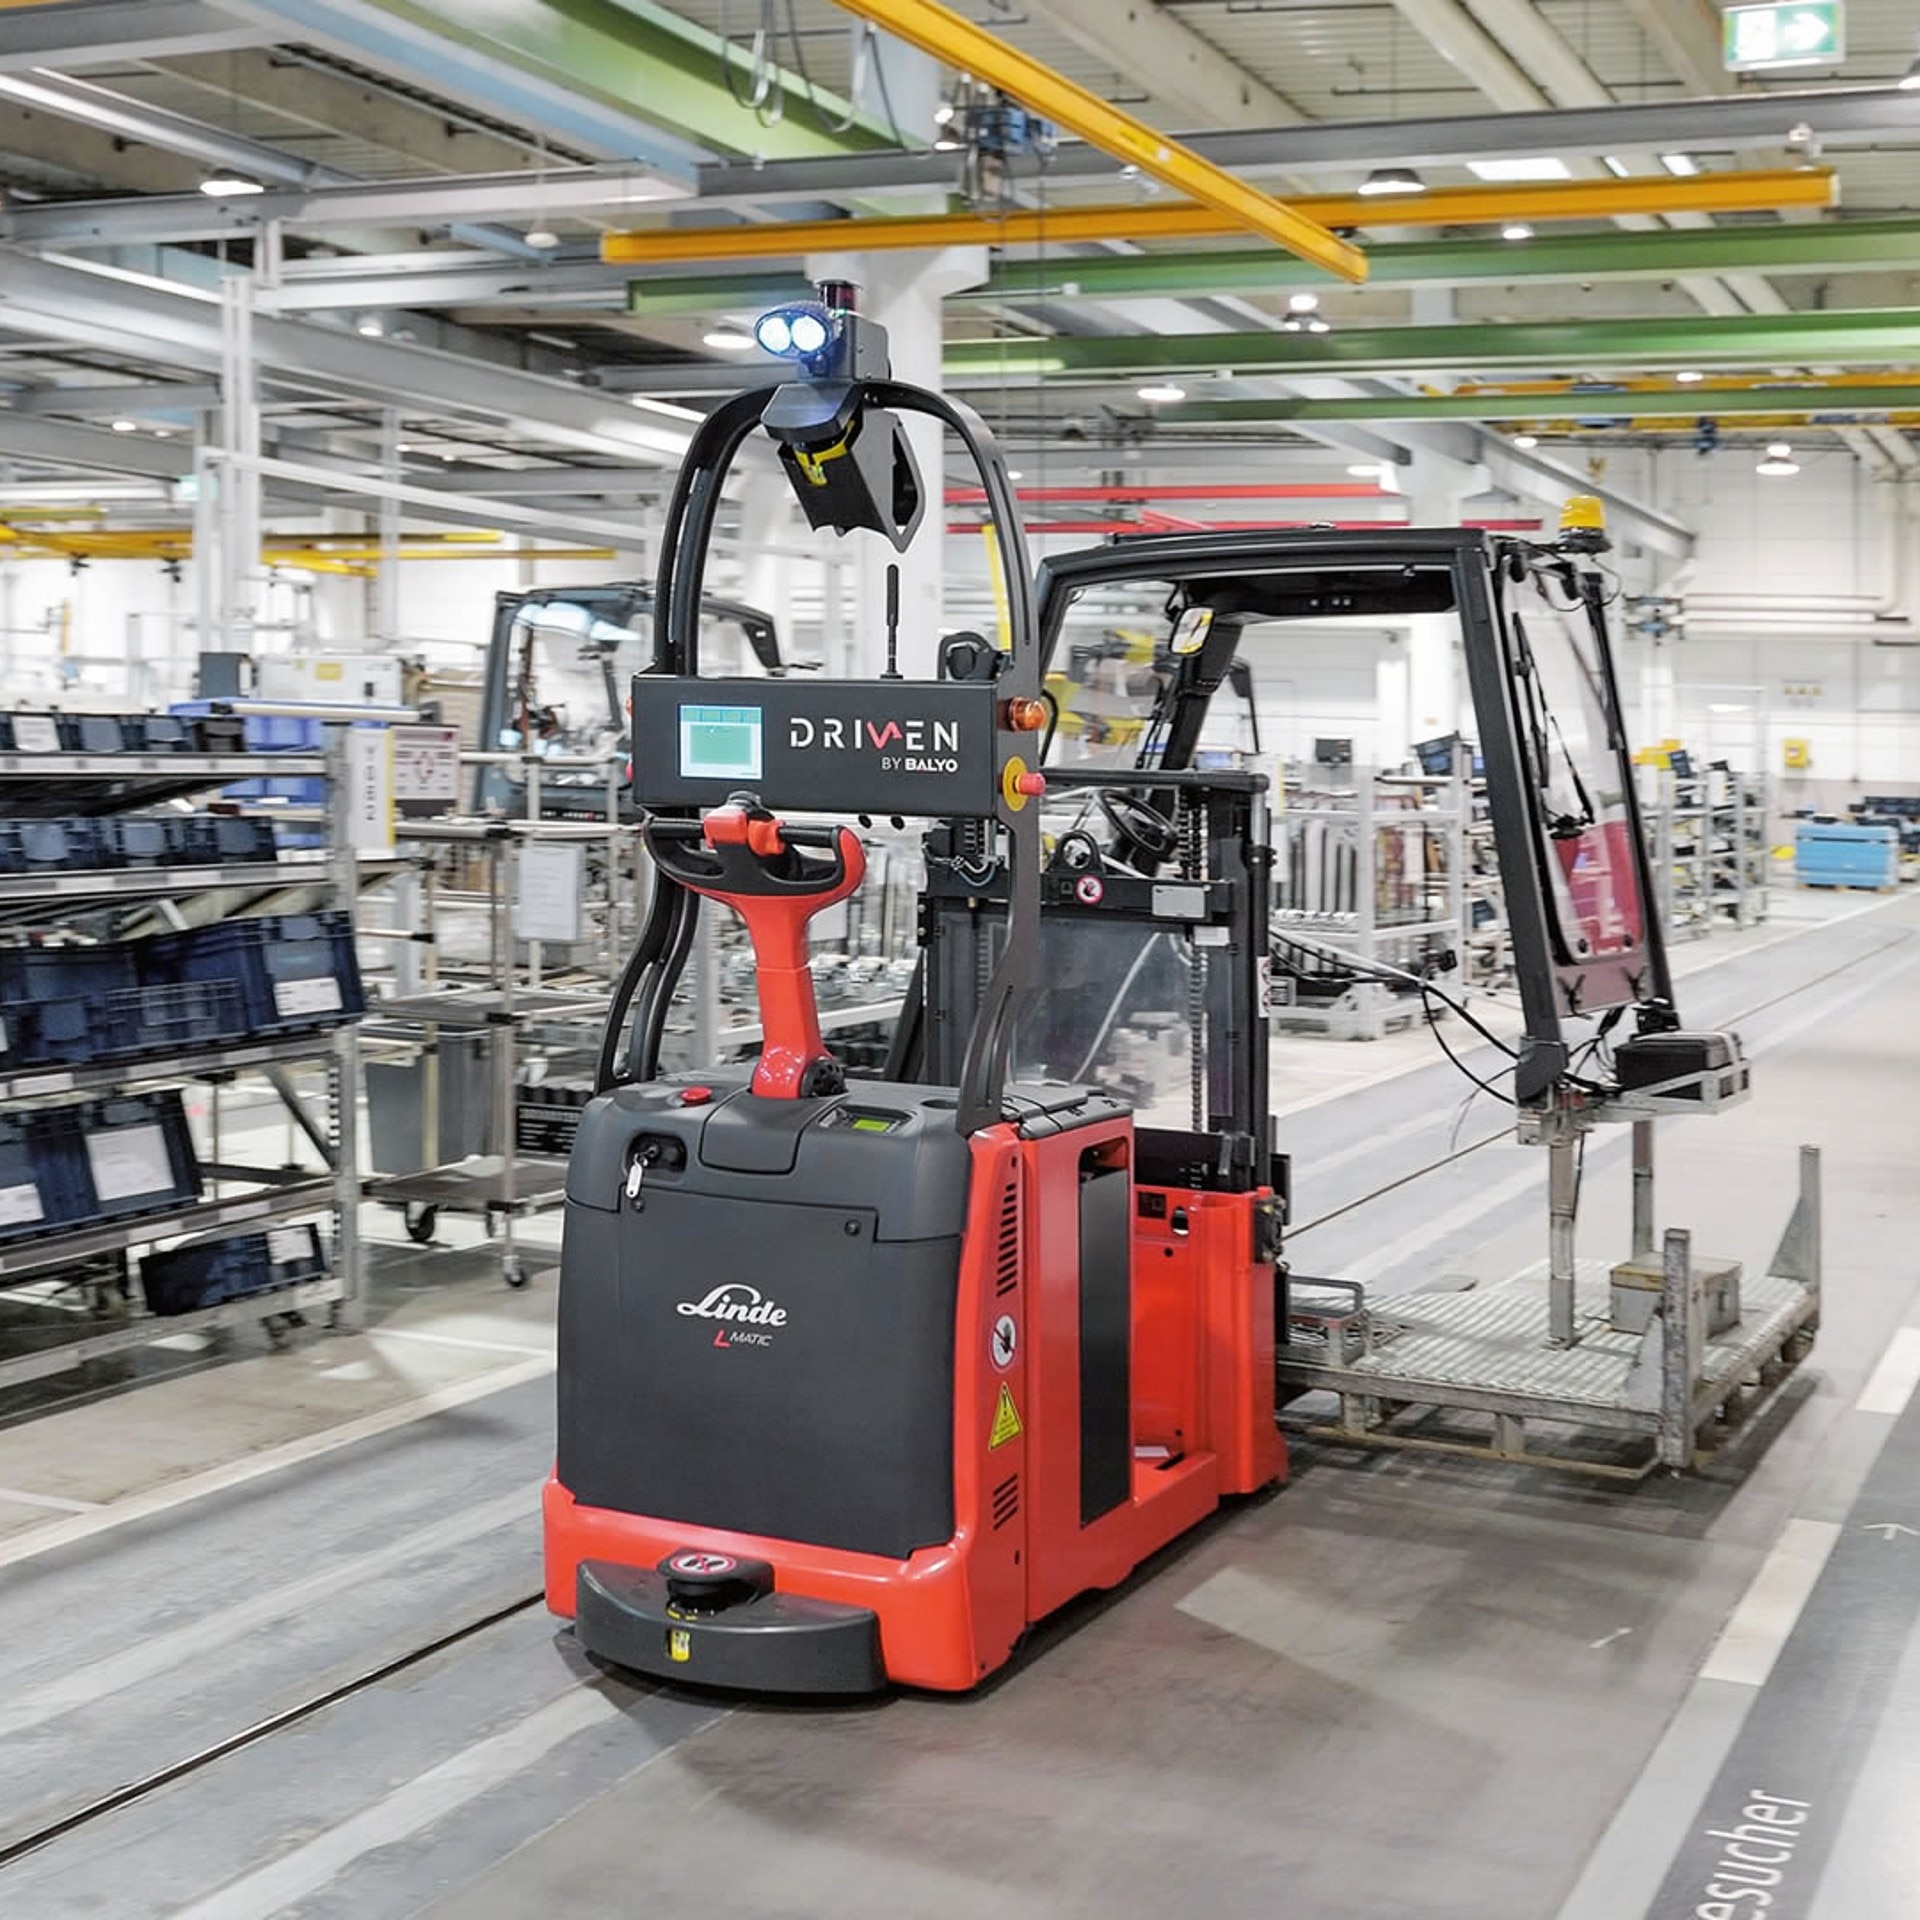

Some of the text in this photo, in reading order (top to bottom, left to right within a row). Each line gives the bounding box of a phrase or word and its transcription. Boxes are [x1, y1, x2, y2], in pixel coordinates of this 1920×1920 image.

[790, 717, 958, 752] DRIVEN
[881, 757, 958, 772] BY BALYO
[676, 1284, 787, 1326] Linde
